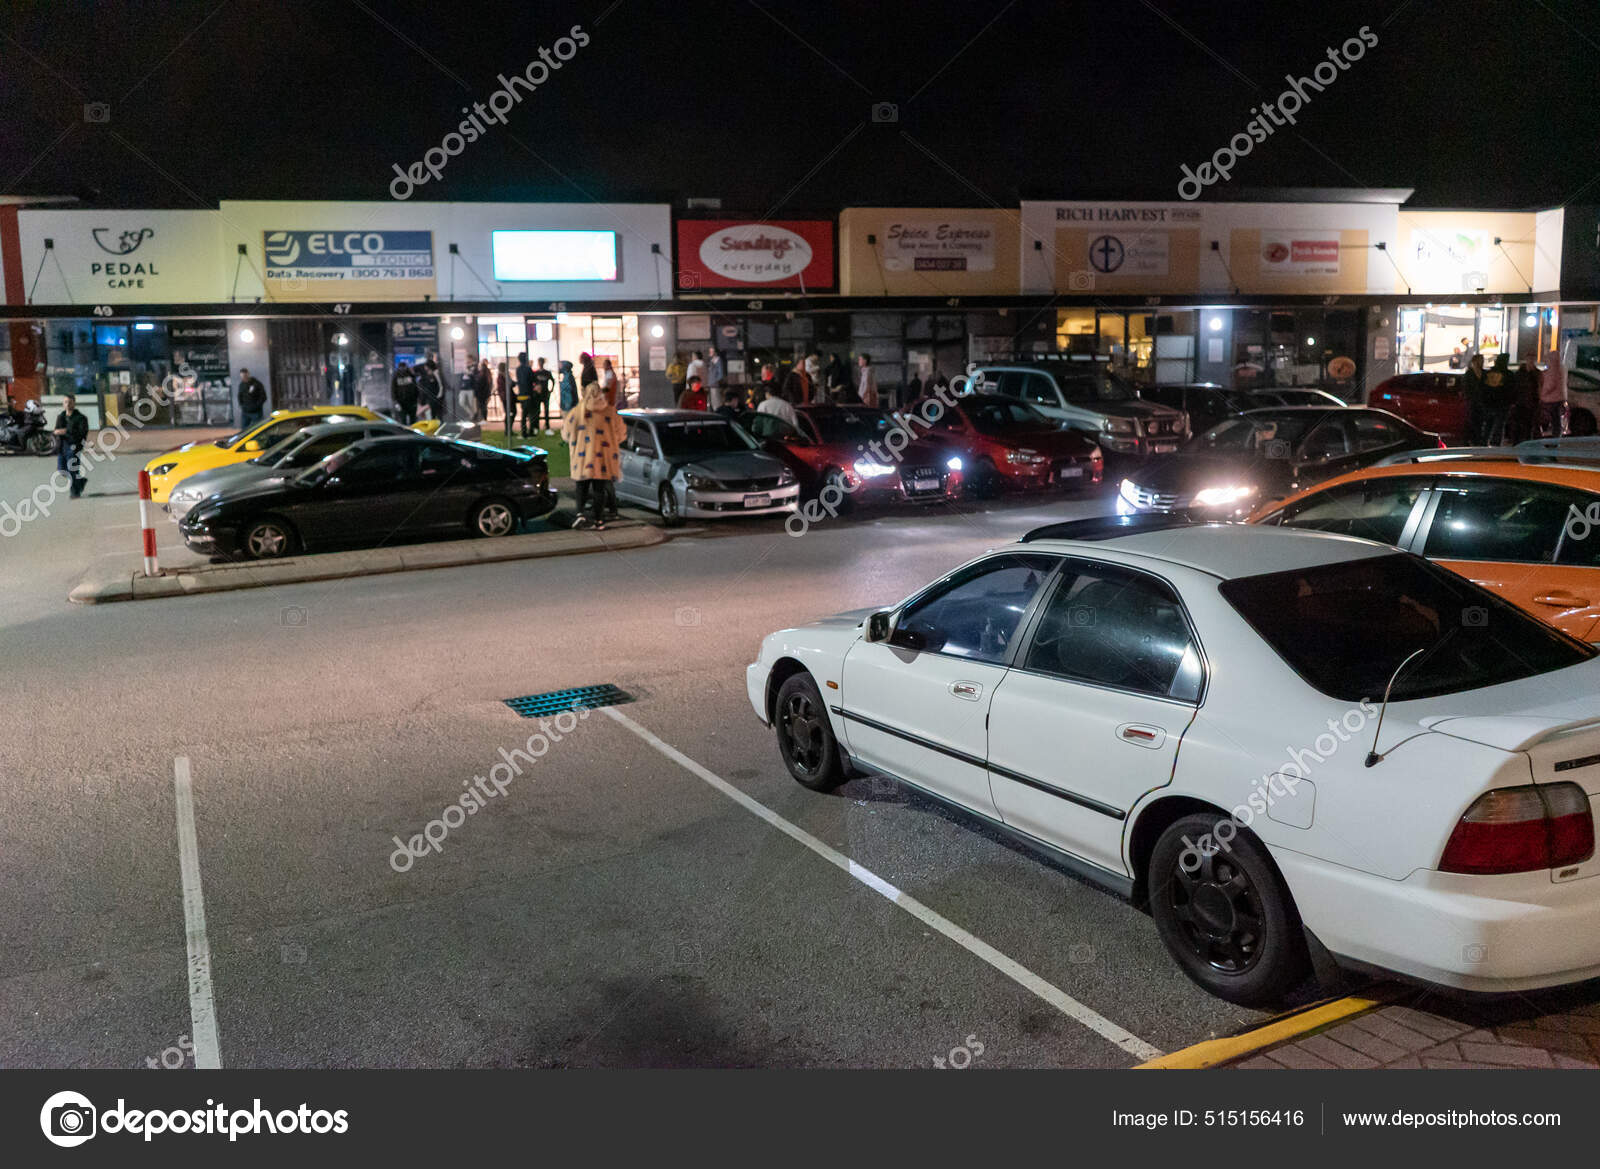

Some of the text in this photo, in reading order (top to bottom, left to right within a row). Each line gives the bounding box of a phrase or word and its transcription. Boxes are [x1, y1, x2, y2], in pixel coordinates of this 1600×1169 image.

[1055, 207, 1094, 221] RICH
[1099, 207, 1168, 221] HARVEST
[888, 224, 991, 243] Spice Express
[308, 233, 385, 254] ELCO
[720, 234, 793, 259] Sundays
[371, 255, 429, 266] TRONICS
[91, 262, 159, 275] PEDAL
[724, 262, 791, 274] everyday
[267, 270, 292, 279] Data
[295, 270, 345, 280] Recovery
[352, 269, 380, 278] 1300
[108, 279, 144, 289] CAFE
[93, 305, 113, 317] 49
[334, 303, 351, 314] 47
